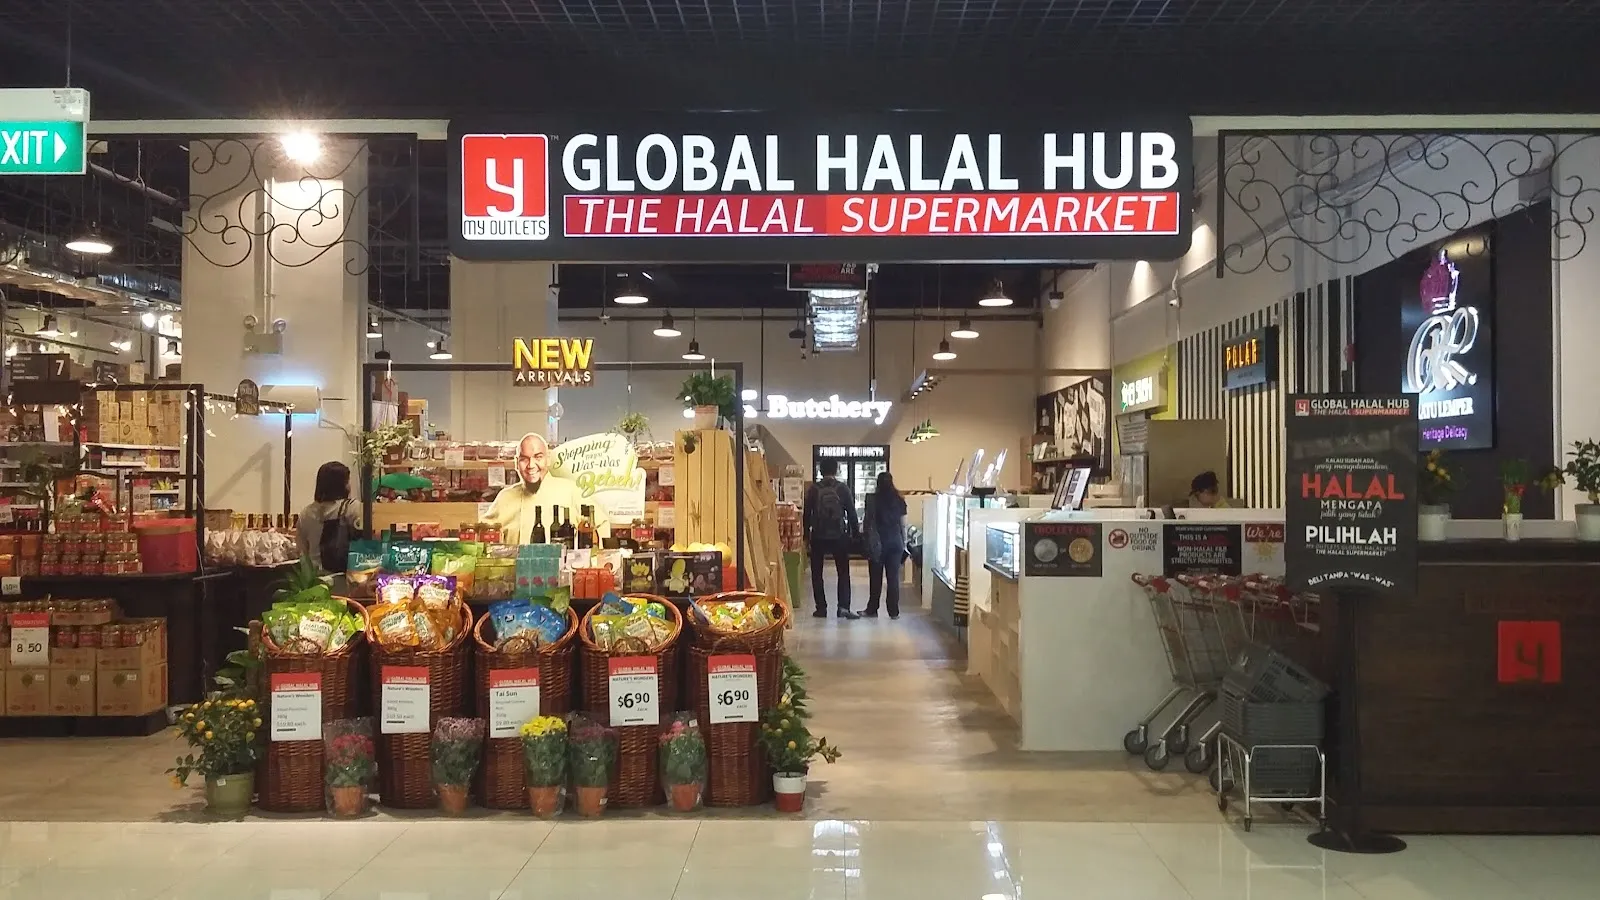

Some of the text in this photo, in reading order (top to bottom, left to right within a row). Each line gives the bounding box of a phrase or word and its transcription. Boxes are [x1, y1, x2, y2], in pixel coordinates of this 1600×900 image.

[0, 130, 48, 164] XIT
[562, 131, 1180, 192] GLOBAL HALAL HUB
[578, 195, 1168, 233] THE HALAL SUPERMARKET
[464, 220, 546, 236] MY OUTLETS
[513, 338, 594, 370] NEW
[1226, 338, 1258, 371] POLAR
[56, 360, 65, 376] 7
[516, 371, 591, 382] ARRIVALS
[766, 394, 892, 425] Butchery
[1310, 399, 1410, 409] GLOBAL HALAL HUB
[1418, 402, 1437, 420] ATU
[1445, 425, 1468, 440] Delicacy
[553, 440, 616, 469] Shopping
[1302, 472, 1404, 500] HALAL
[1320, 500, 1382, 510] MENGAPA
[1247, 526, 1283, 538] We're
[1306, 525, 1396, 544] PILIHLAH
[1308, 574, 1324, 586] BELI
[1324, 571, 1348, 580] TANPA
